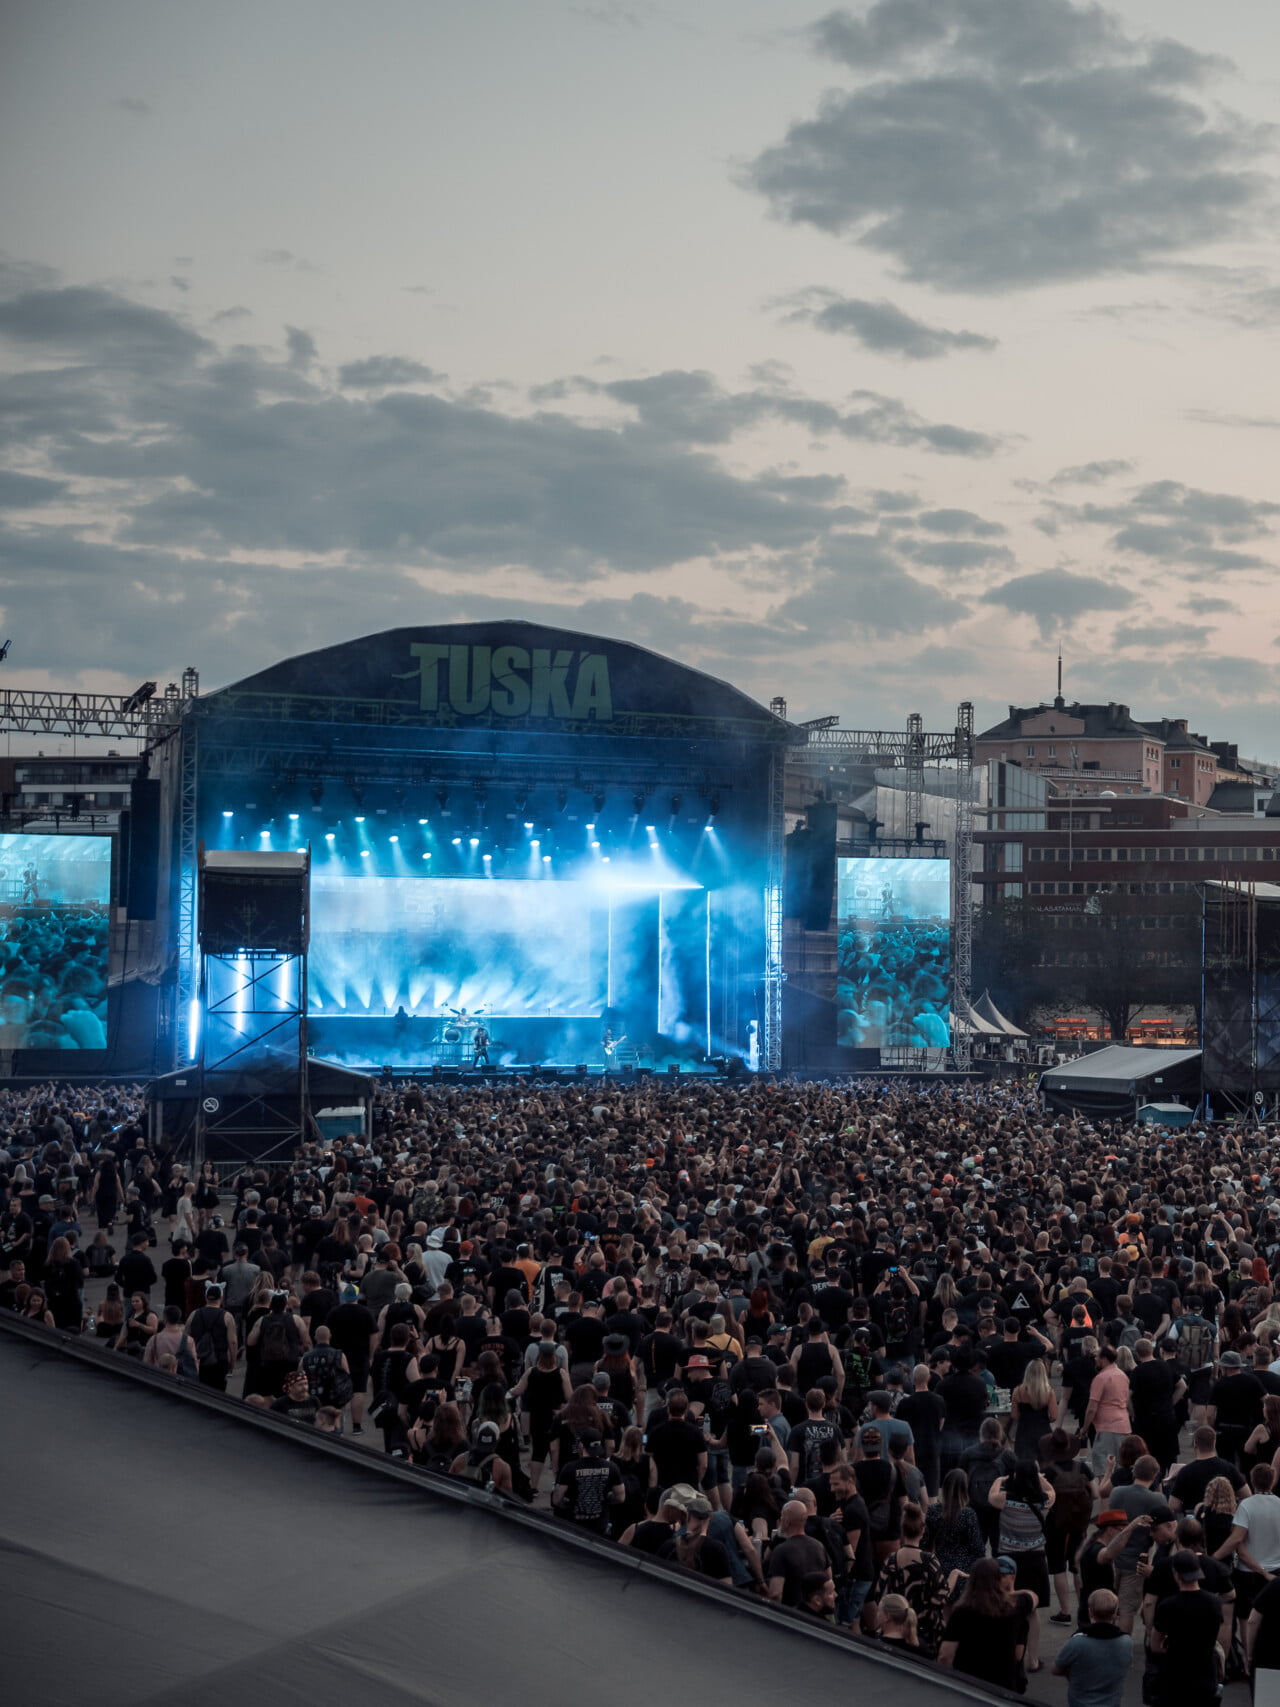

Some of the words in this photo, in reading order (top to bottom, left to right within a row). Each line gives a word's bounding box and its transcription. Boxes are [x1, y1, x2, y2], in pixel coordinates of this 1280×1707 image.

[409, 642, 613, 720] TUSKA
[806, 1426, 834, 1435] ARCH
[575, 1467, 610, 1477] FIREPOWER
